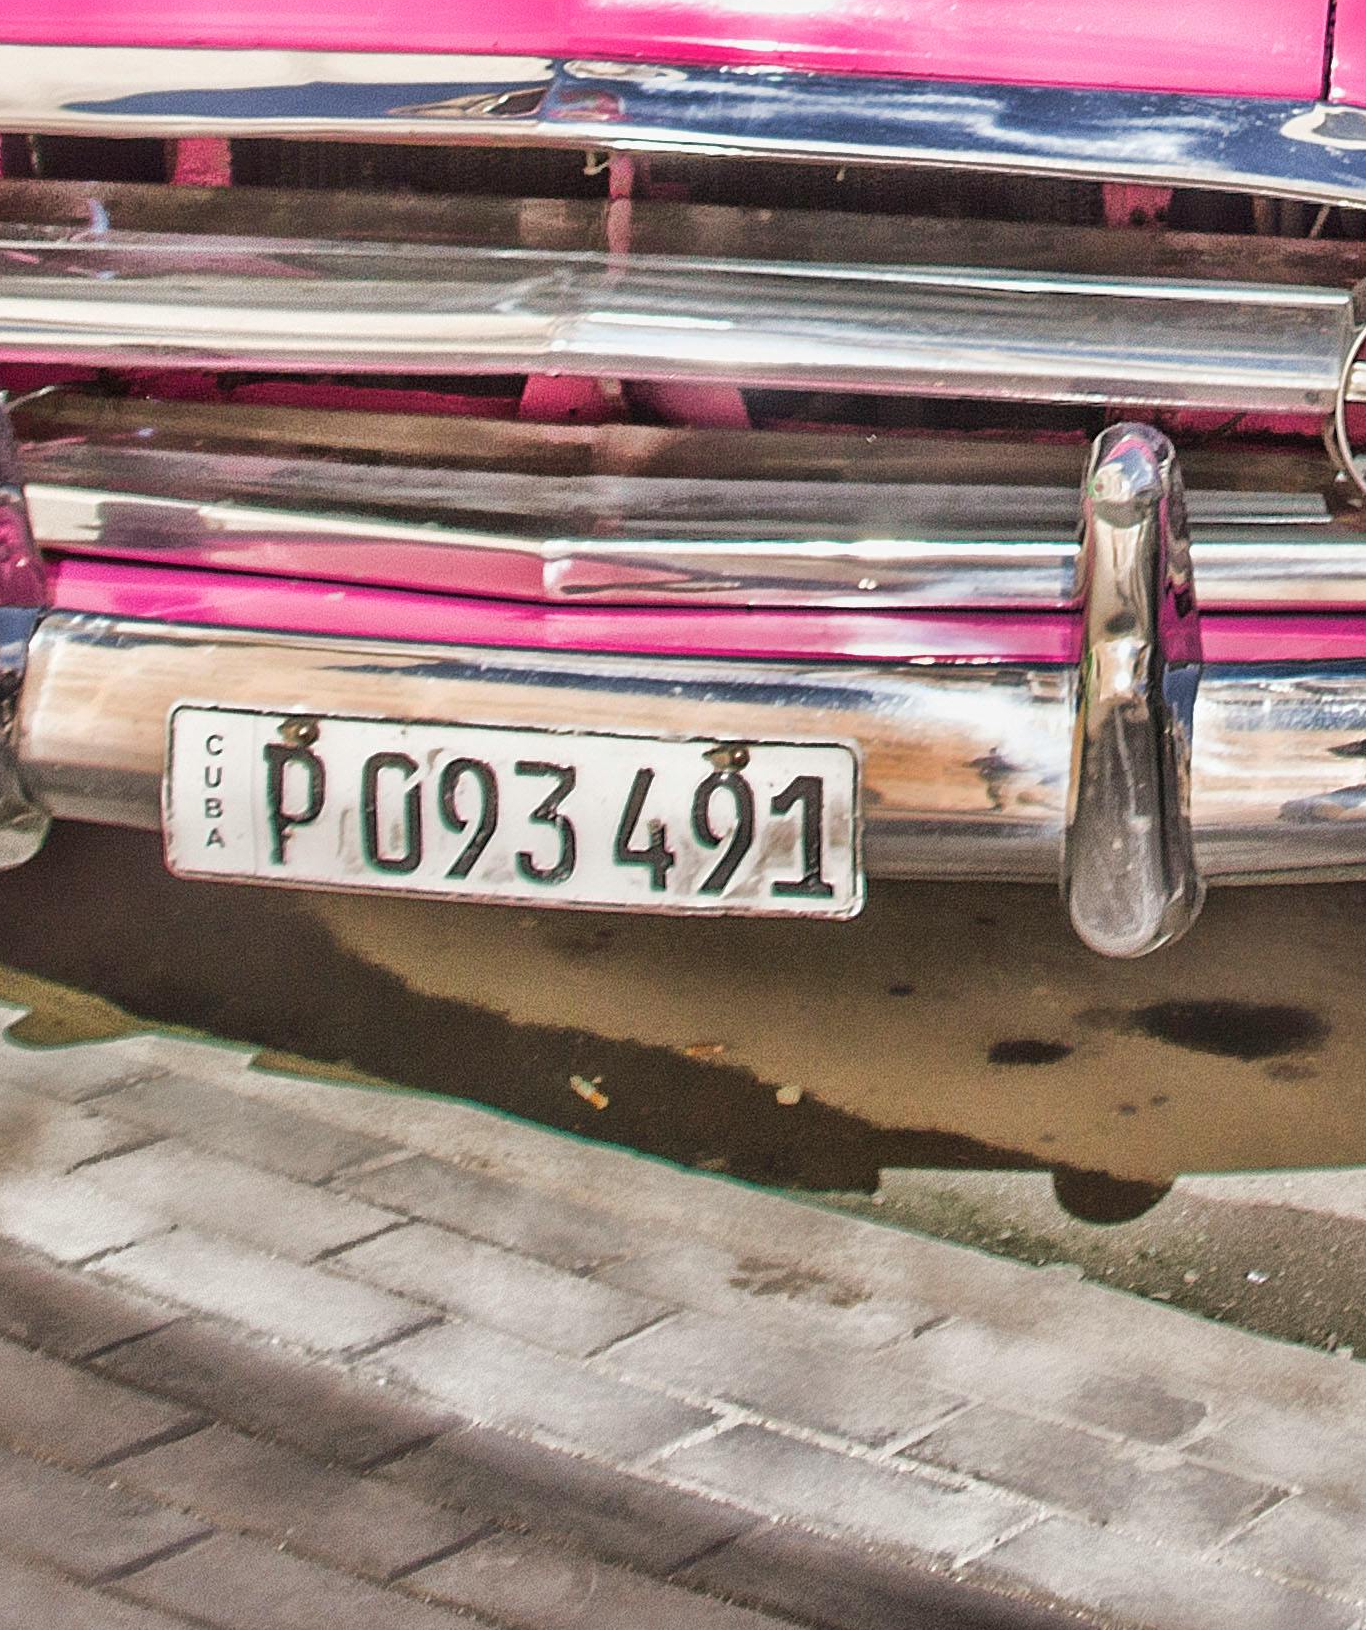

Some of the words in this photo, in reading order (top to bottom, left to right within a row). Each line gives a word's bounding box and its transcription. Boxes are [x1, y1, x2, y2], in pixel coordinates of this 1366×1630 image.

[204, 733, 226, 849] CUBA
[263, 744, 327, 866] P
[361, 752, 578, 884] 093
[614, 767, 835, 899] 491
